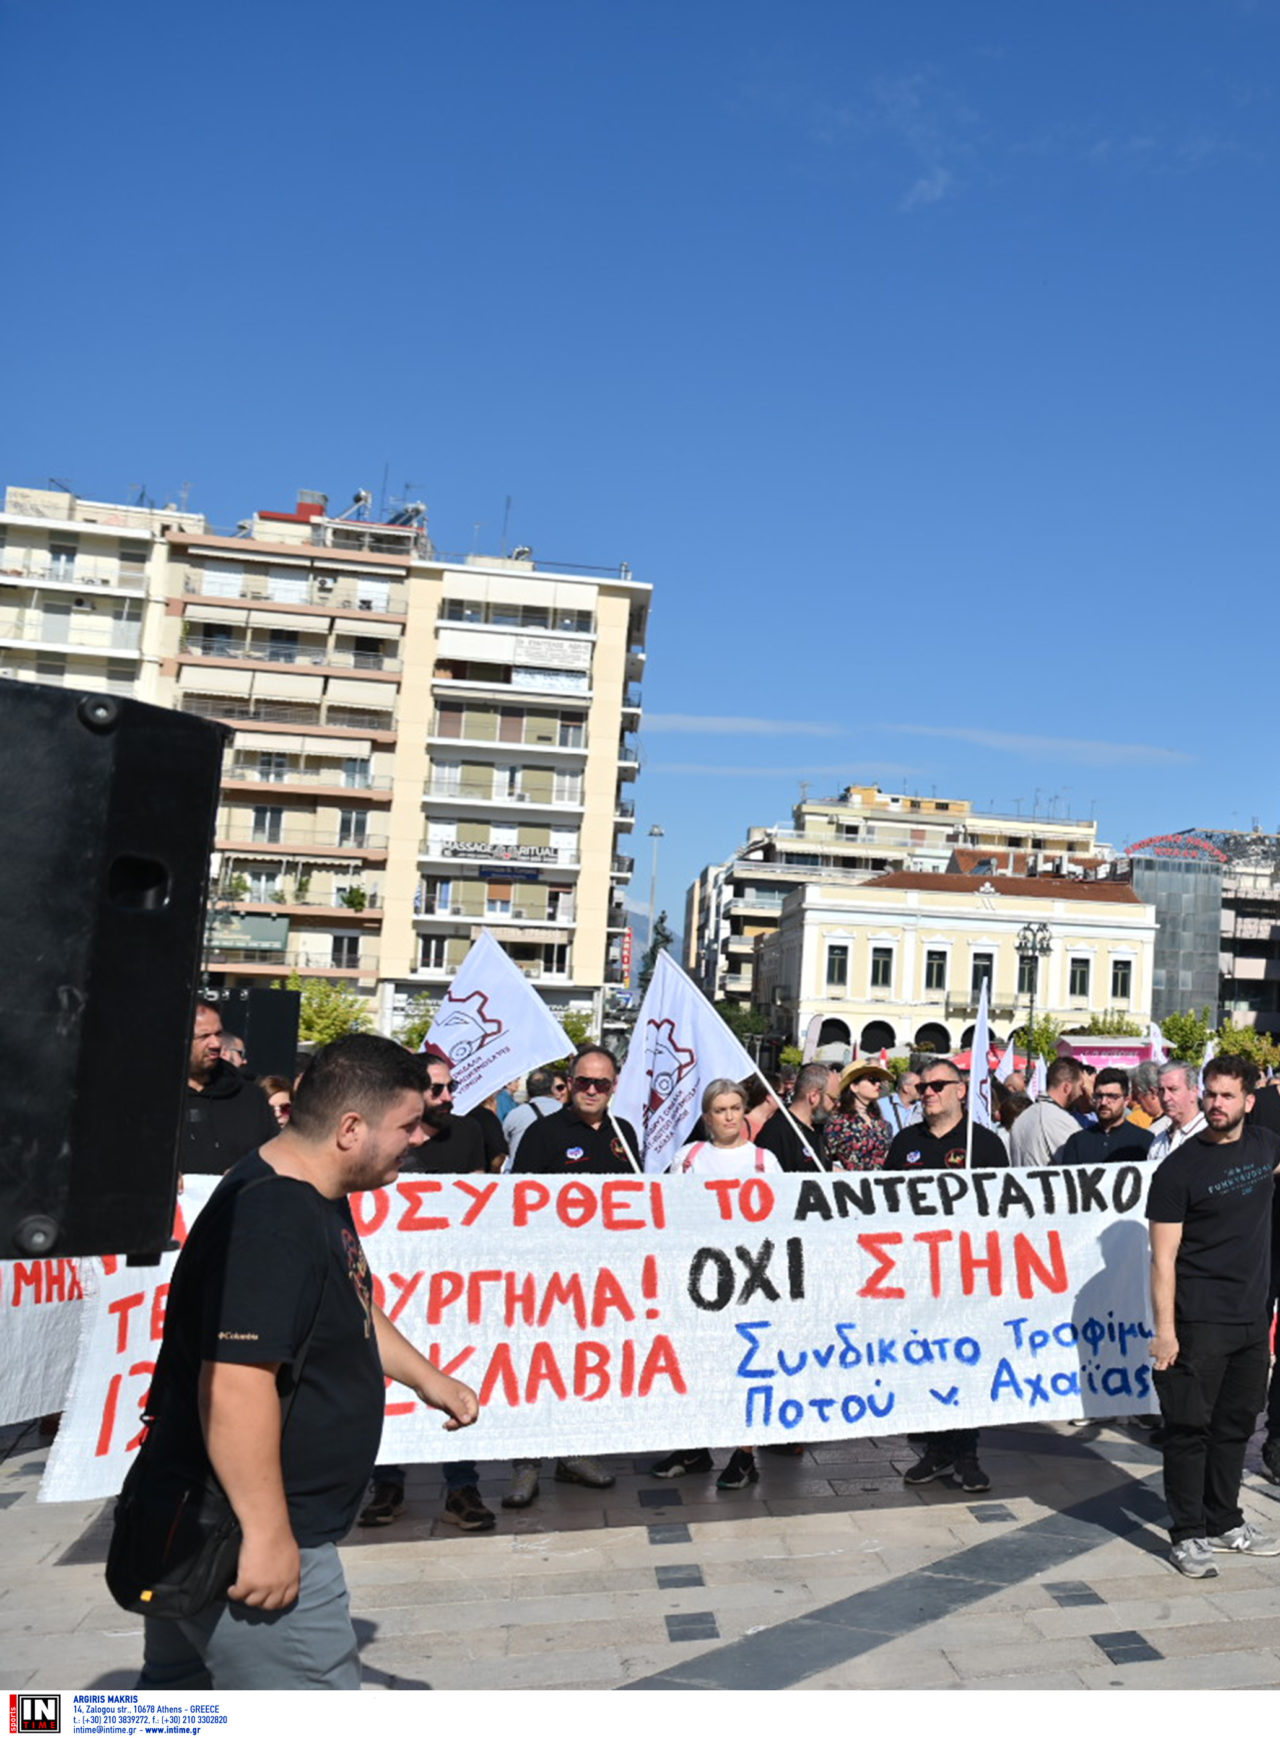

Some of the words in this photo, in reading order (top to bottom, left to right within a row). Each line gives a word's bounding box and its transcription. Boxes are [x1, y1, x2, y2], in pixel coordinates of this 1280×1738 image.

[443, 841, 494, 852] MASSAGE
[518, 846, 556, 856] RITUAL
[349, 1179, 666, 1237] ΟΣΥΡΘΕΙ
[704, 1178, 775, 1222] ΤΟ
[794, 1165, 1143, 1222] ΑΝΤΕΡΓΑΤΙΚΟ
[688, 1236, 806, 1312] ΟΧΙ
[857, 1229, 1069, 1300] ΣΤΗΝ
[735, 1320, 982, 1379] Συνδικάτο
[745, 1378, 895, 1429] Ποτού
